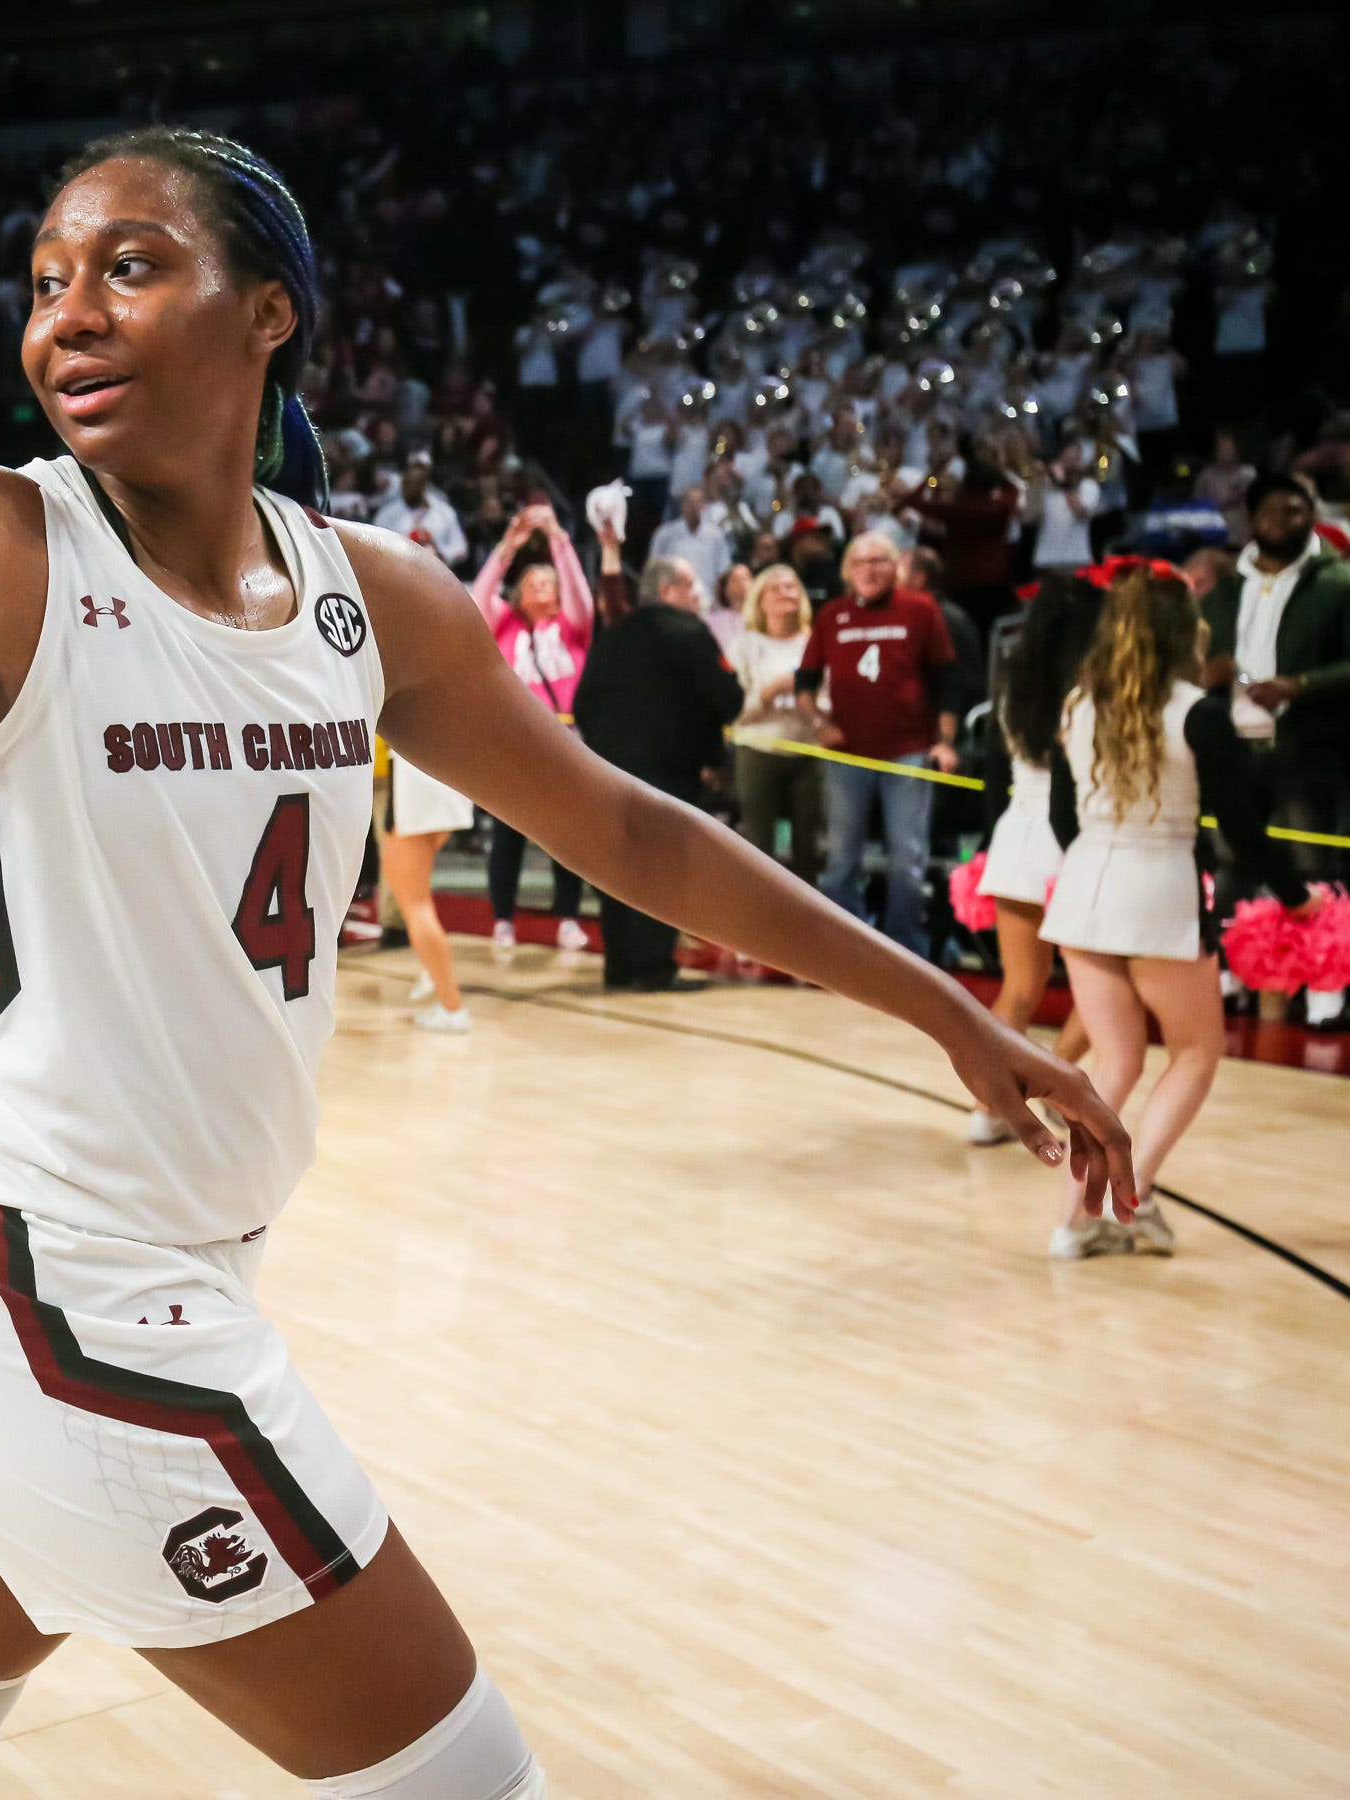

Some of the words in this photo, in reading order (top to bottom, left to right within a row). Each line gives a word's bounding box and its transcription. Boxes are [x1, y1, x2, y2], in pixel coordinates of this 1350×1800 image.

[319, 597, 362, 651] SEC
[857, 643, 880, 683] 4
[103, 722, 233, 774] SOUTH
[242, 718, 372, 771] CAROLINA
[231, 792, 315, 1002] 4
